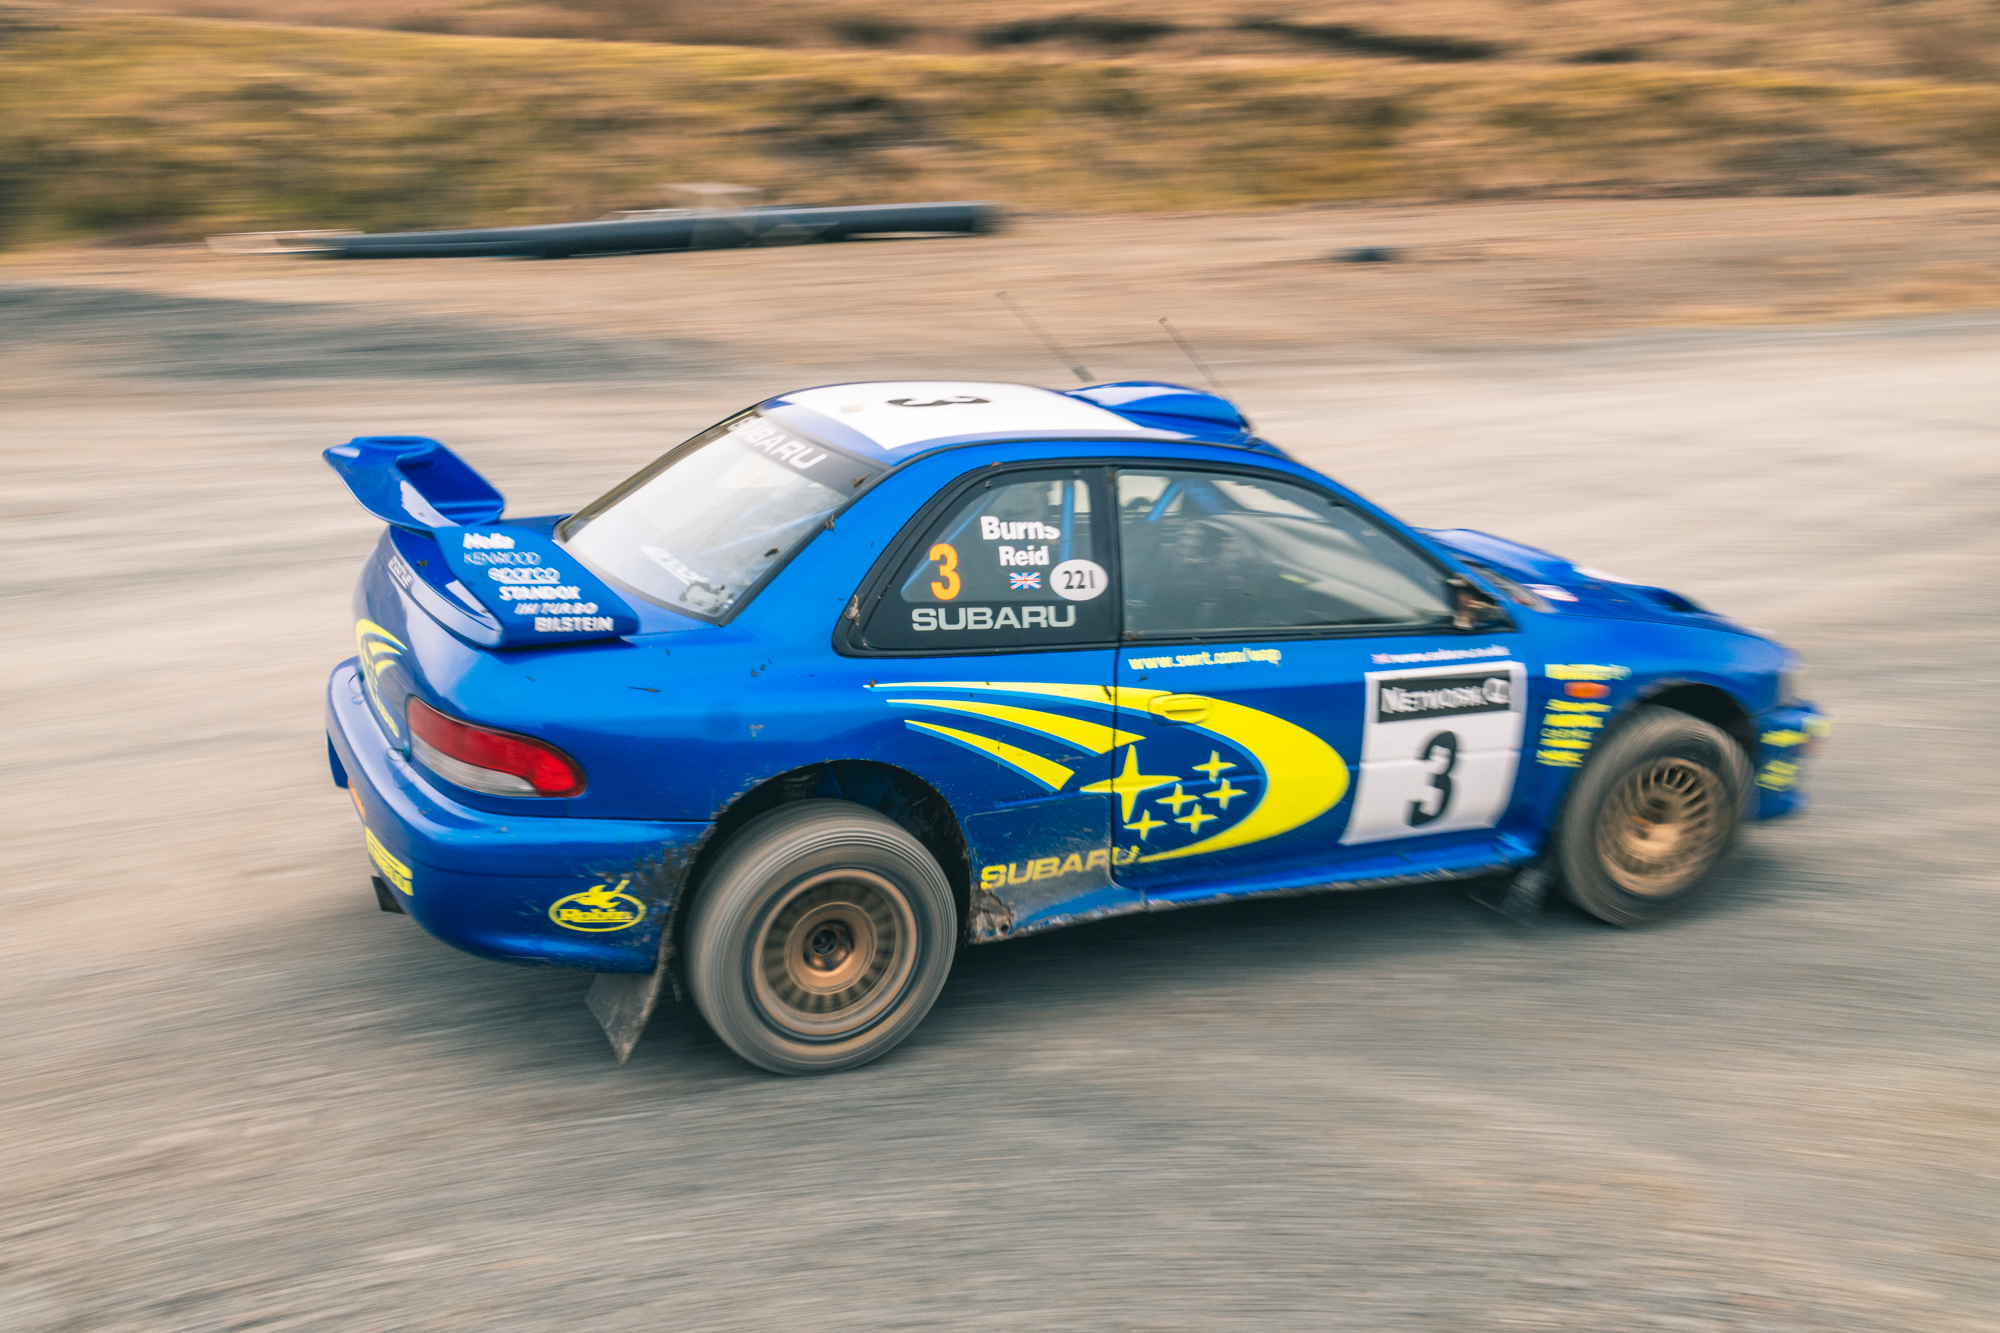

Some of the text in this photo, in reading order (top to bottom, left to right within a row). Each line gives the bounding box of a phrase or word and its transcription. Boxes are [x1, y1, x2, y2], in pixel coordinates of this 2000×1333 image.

[980, 515, 1061, 541] Burns
[463, 551, 542, 566] KENWOOD
[999, 545, 1050, 566] Reid
[929, 543, 961, 600] 3
[1062, 569, 1096, 590] 221
[499, 585, 582, 602] STANDOX
[534, 616, 614, 633] BILSTEIN
[911, 605, 1076, 631] SUBARU
[1403, 731, 1464, 829] 3
[980, 845, 1140, 890] SUBARU
